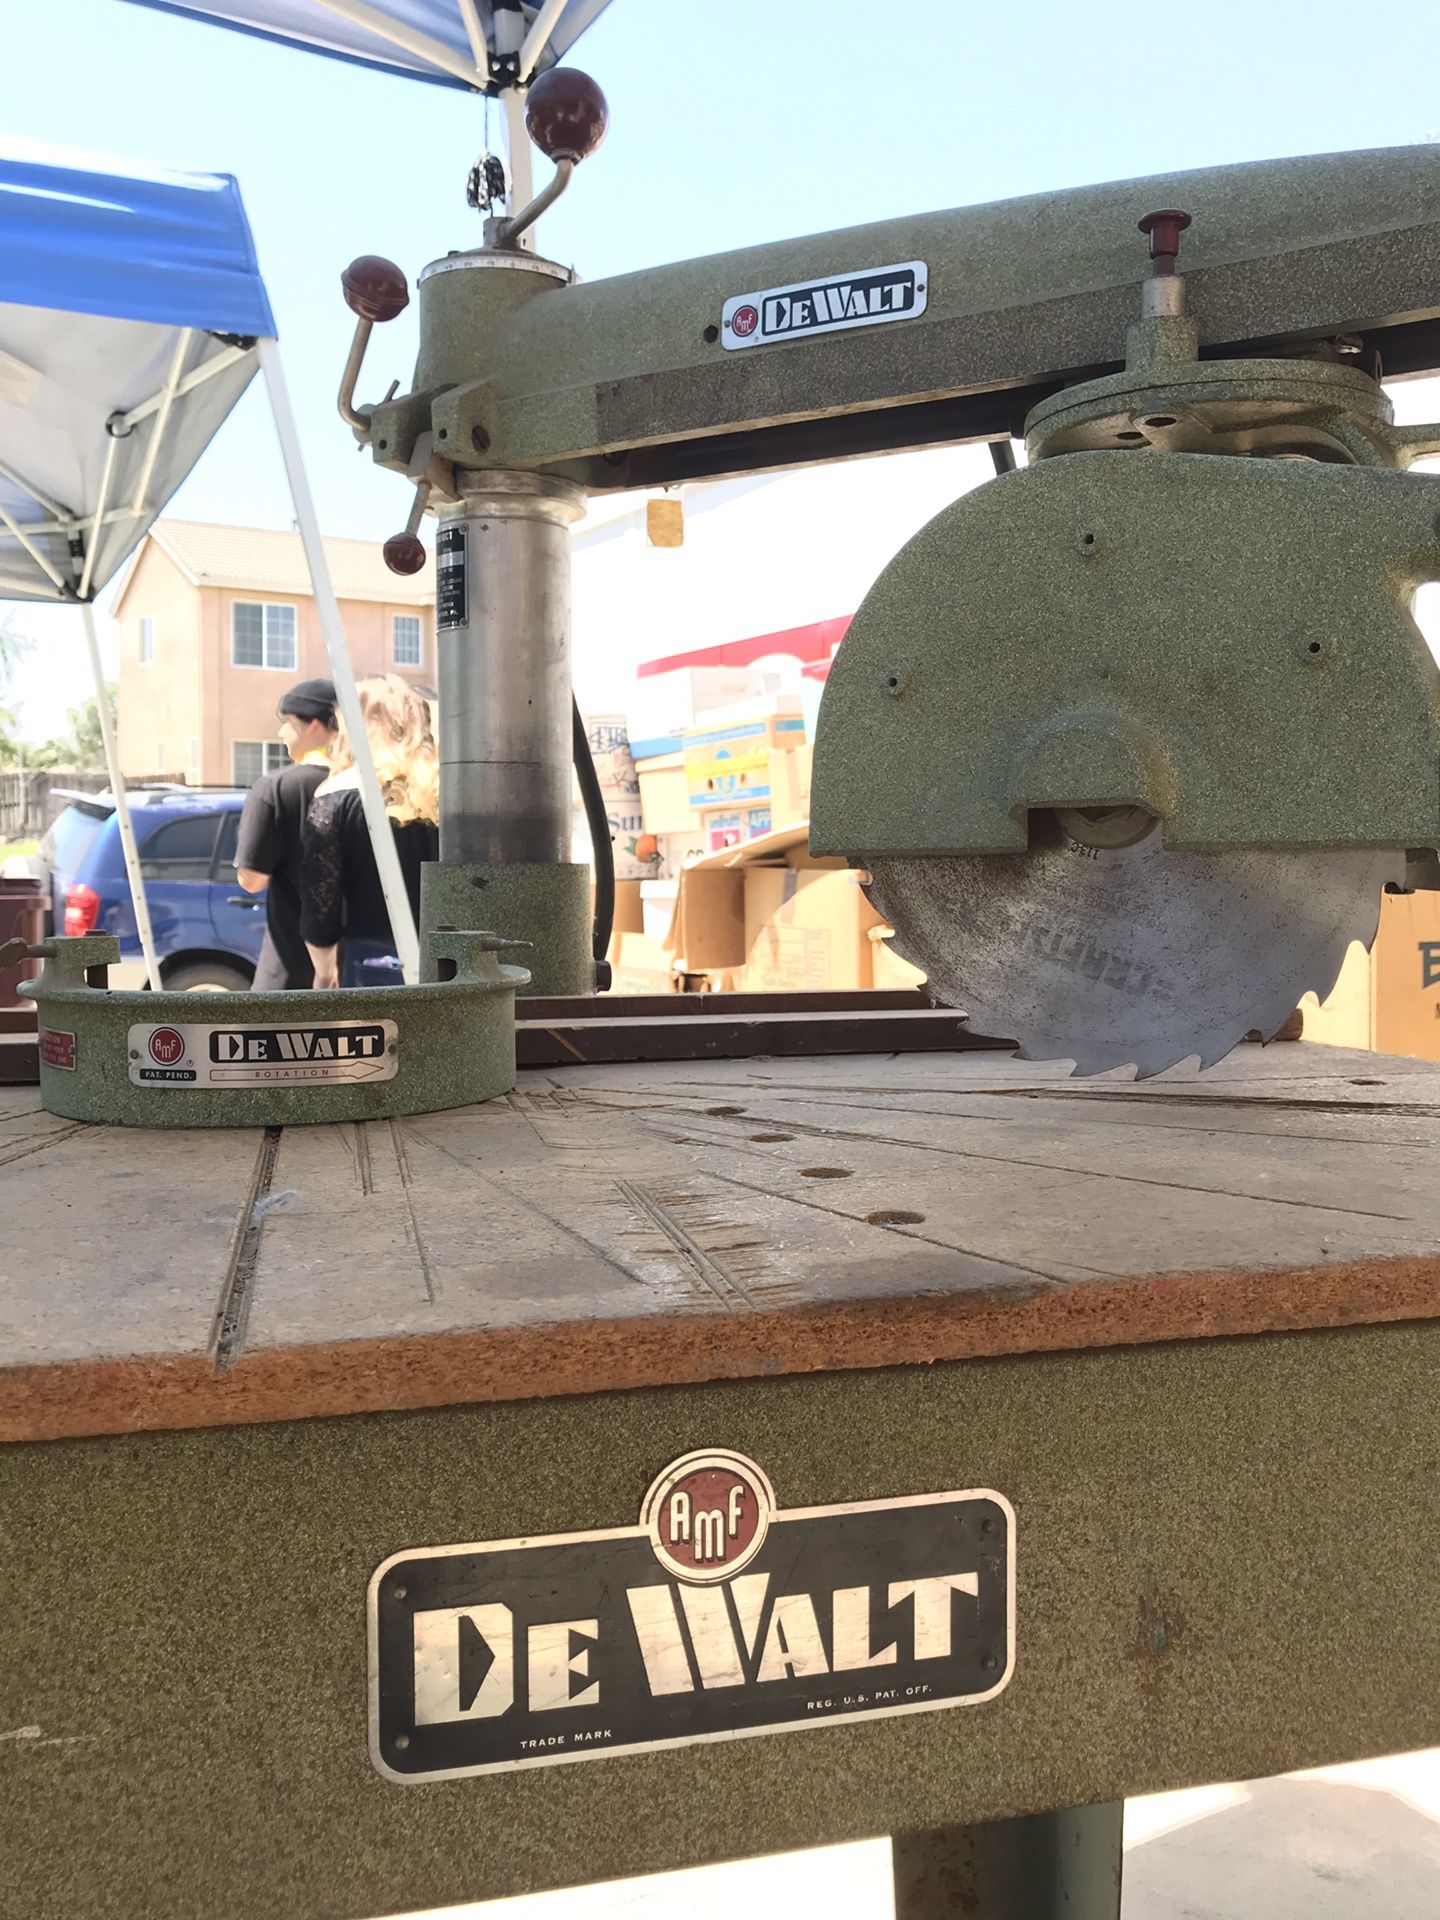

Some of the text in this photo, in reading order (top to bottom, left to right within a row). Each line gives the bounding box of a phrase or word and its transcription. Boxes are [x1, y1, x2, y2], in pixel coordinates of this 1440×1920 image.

[218, 1033, 378, 1060] DE WALT
[166, 1071, 192, 1079] PEND.
[255, 1069, 328, 1078] ROTATION
[413, 1571, 979, 1727] DE WALT
[807, 1685, 932, 1710] REG. U.S. PAT. OFF.
[520, 1729, 611, 1749] TRADE MARK
